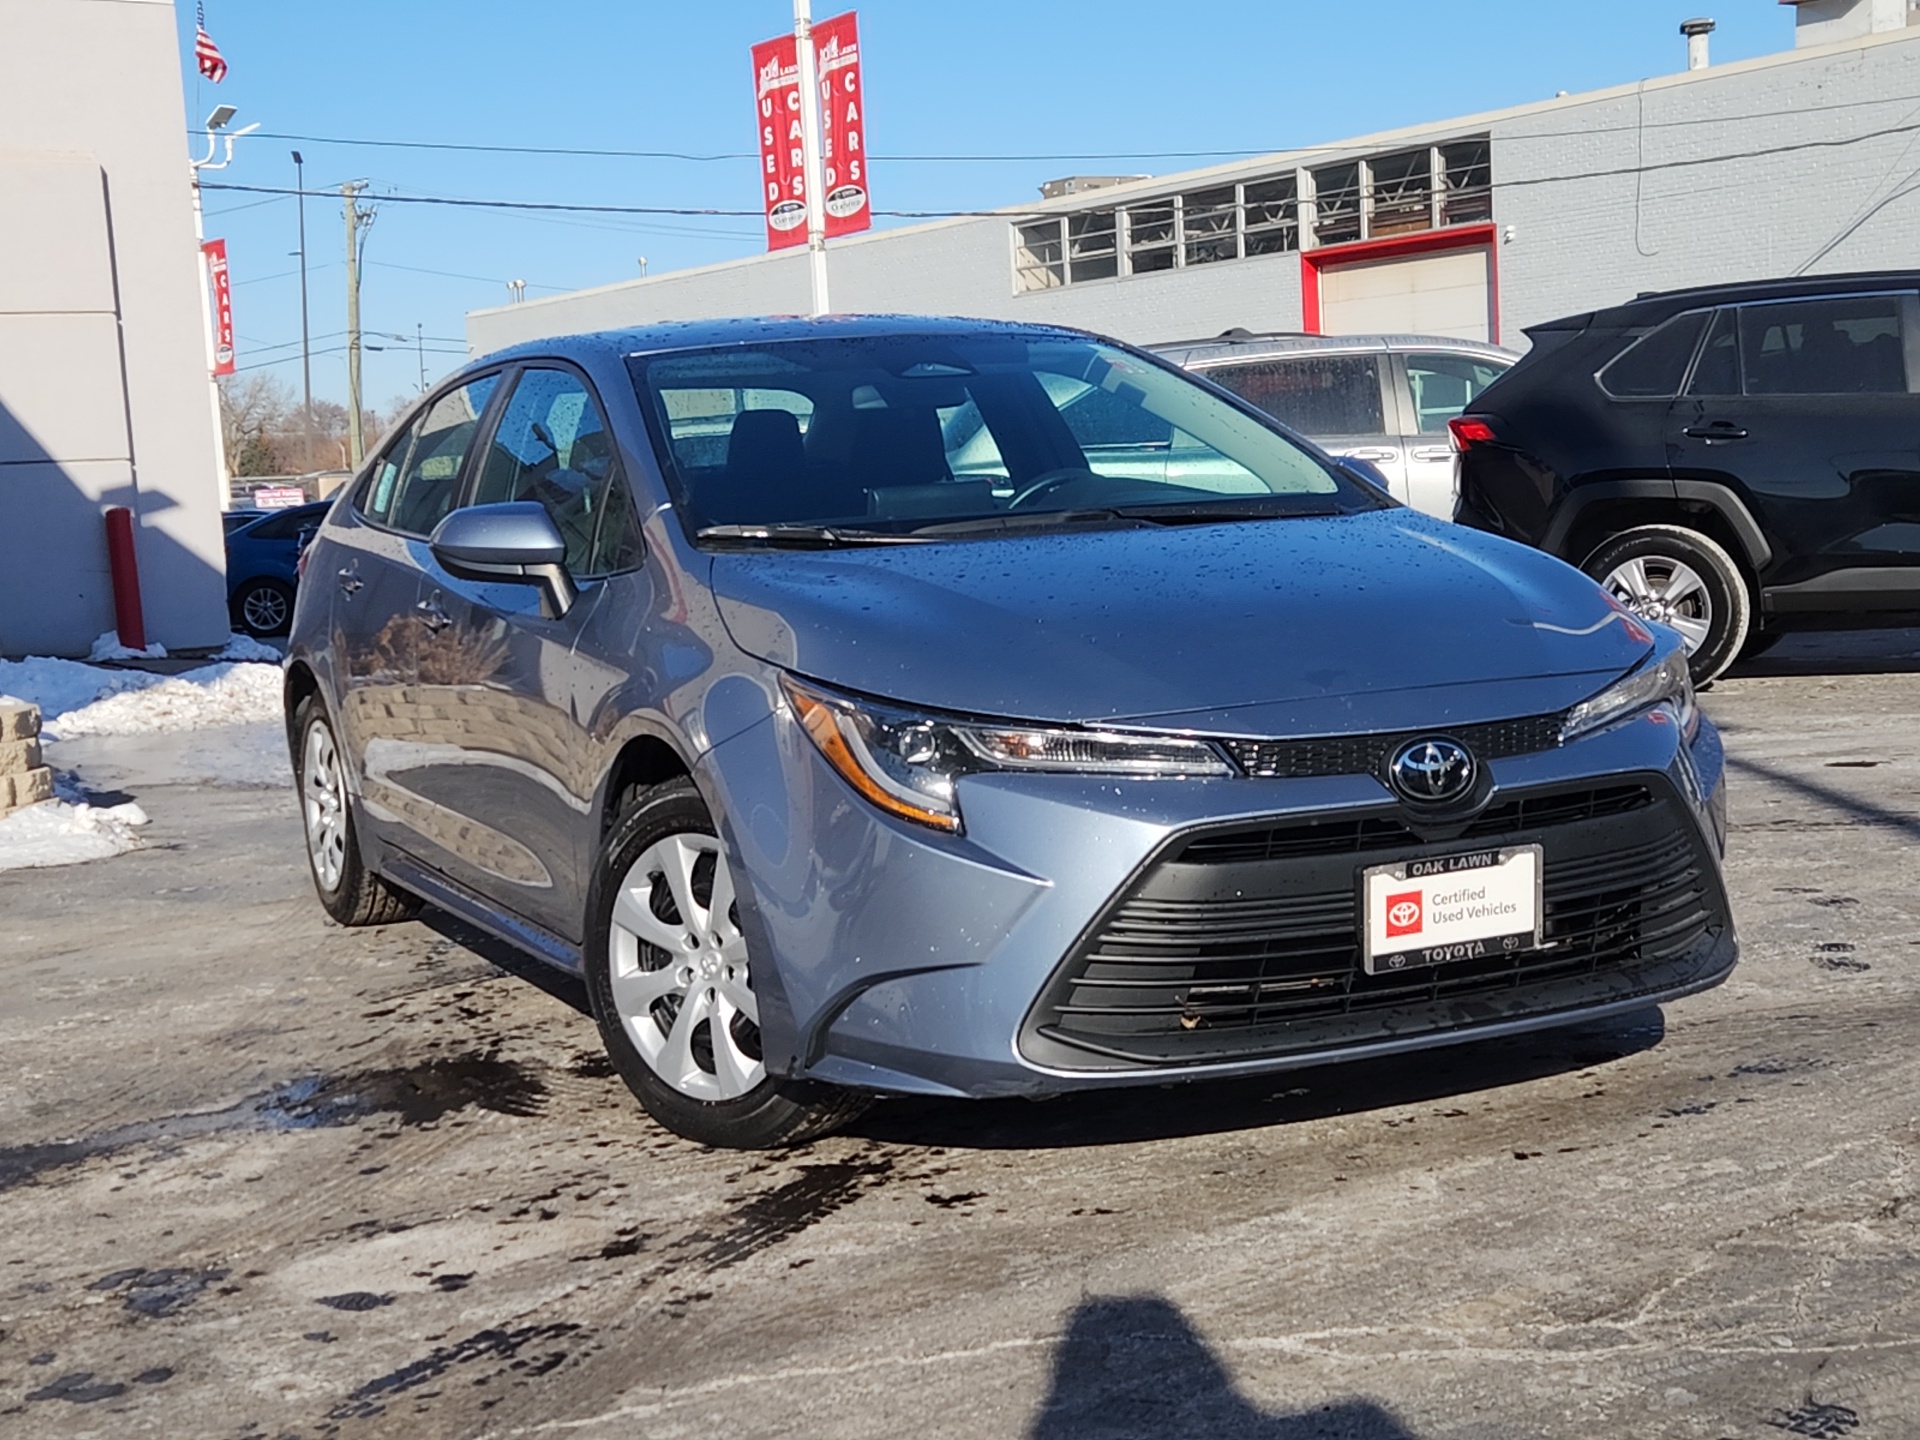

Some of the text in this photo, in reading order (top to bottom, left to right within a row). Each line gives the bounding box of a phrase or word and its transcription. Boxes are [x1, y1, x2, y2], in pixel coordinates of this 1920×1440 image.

[761, 98, 779, 201] USED
[787, 90, 804, 196] CARS
[821, 80, 836, 187] USED
[844, 71, 861, 181] CARS
[219, 274, 231, 343] CARS
[1412, 853, 1493, 876] OAK LAWN
[1432, 886, 1486, 906] Certified
[1432, 902, 1517, 924] Used Vehicles
[1422, 941, 1486, 963] TOYOTA
